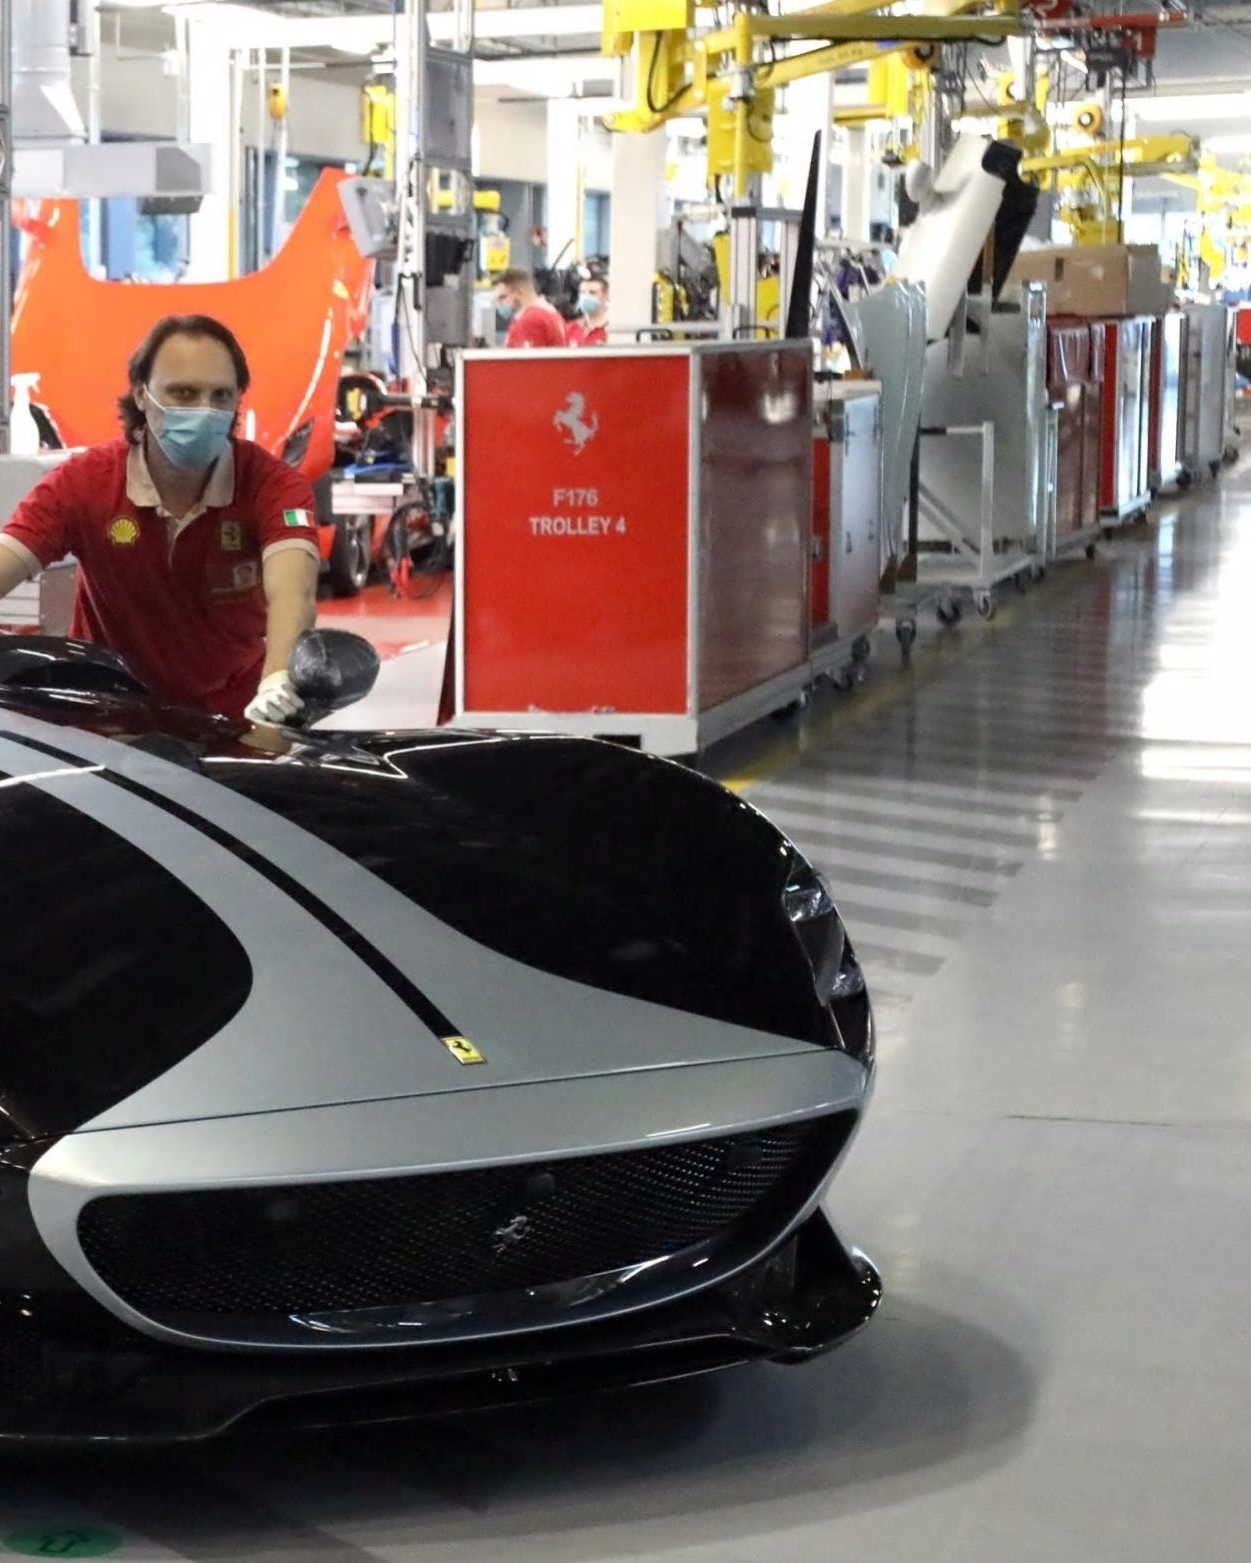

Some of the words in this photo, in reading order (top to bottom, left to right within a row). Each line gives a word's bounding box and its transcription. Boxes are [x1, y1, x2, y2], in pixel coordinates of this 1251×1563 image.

[553, 488, 598, 507] F176
[529, 516, 611, 535] TROLLEY
[615, 516, 627, 535] 4
